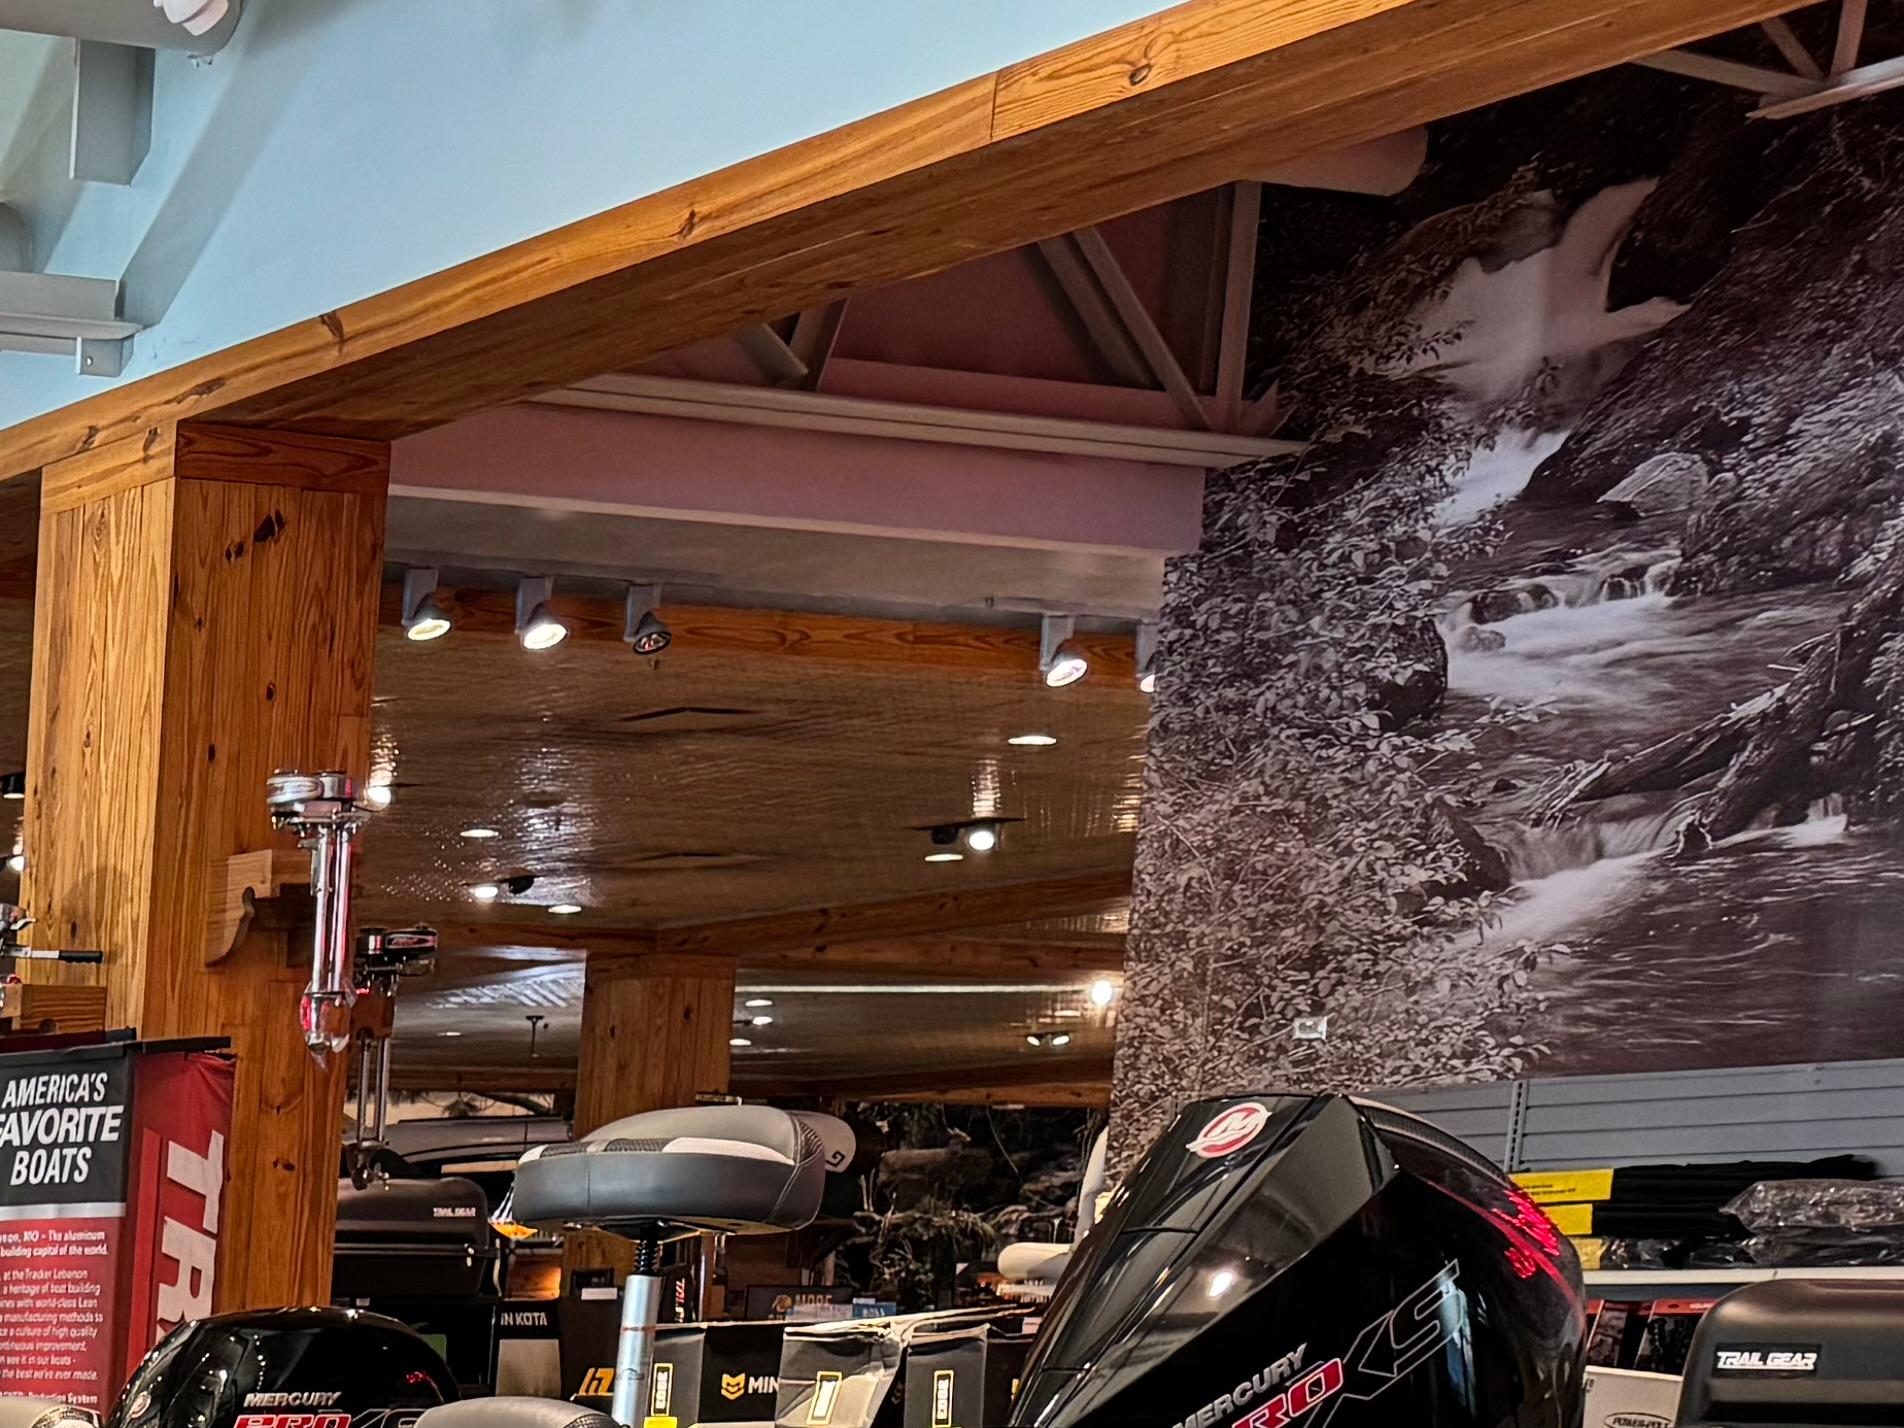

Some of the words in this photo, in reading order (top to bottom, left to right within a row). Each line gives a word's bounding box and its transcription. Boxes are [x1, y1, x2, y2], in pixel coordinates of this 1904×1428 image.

[1, 1072, 109, 1108] AMERICA'S
[9, 1146, 93, 1186] BOATS
[1717, 1351, 1765, 1369] TRAIL
[1766, 1352, 1818, 1371] GEAR
[243, 1391, 345, 1408] MERCURY
